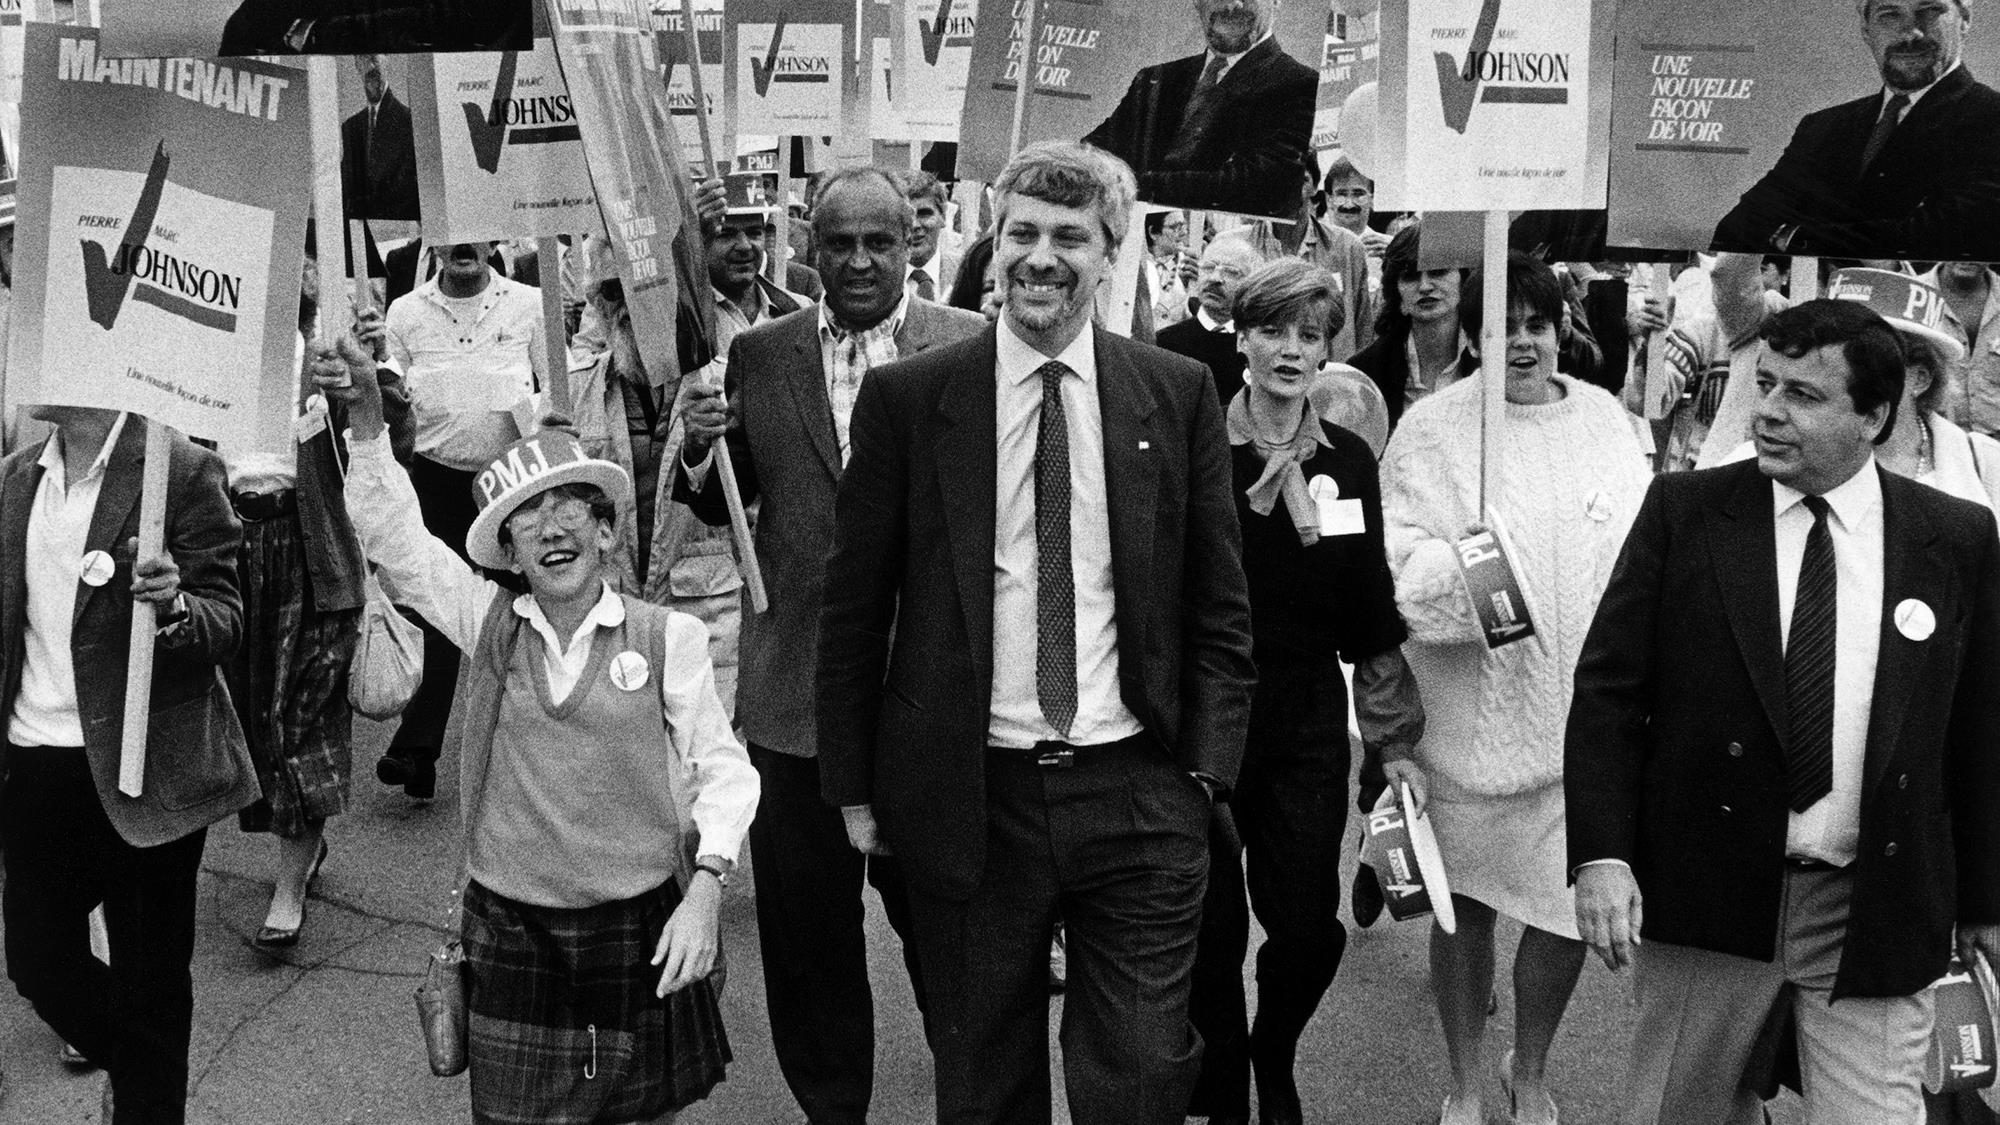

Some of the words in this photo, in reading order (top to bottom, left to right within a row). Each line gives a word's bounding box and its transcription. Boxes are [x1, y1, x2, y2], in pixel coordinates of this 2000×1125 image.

[932, 16, 975, 36] JOHN
[1430, 27, 1468, 40] PIERRE
[763, 55, 830, 72] JOHNSON
[1463, 51, 1569, 83] JOHNSON
[1651, 55, 1693, 76] UNE
[58, 37, 290, 121] MAINTENANT
[1650, 76, 1754, 99] NOUVELLE
[489, 95, 577, 127] JOHNS
[1650, 97, 1713, 121] FAÇON
[1648, 119, 1678, 140] DE
[1680, 121, 1724, 142] VOIR
[747, 155, 774, 170] PMJ
[78, 214, 121, 229] PIERRE
[155, 225, 180, 244] MARC
[112, 243, 242, 309] JOHNSON
[1902, 282, 1946, 330] PM
[477, 439, 549, 501] PMJ
